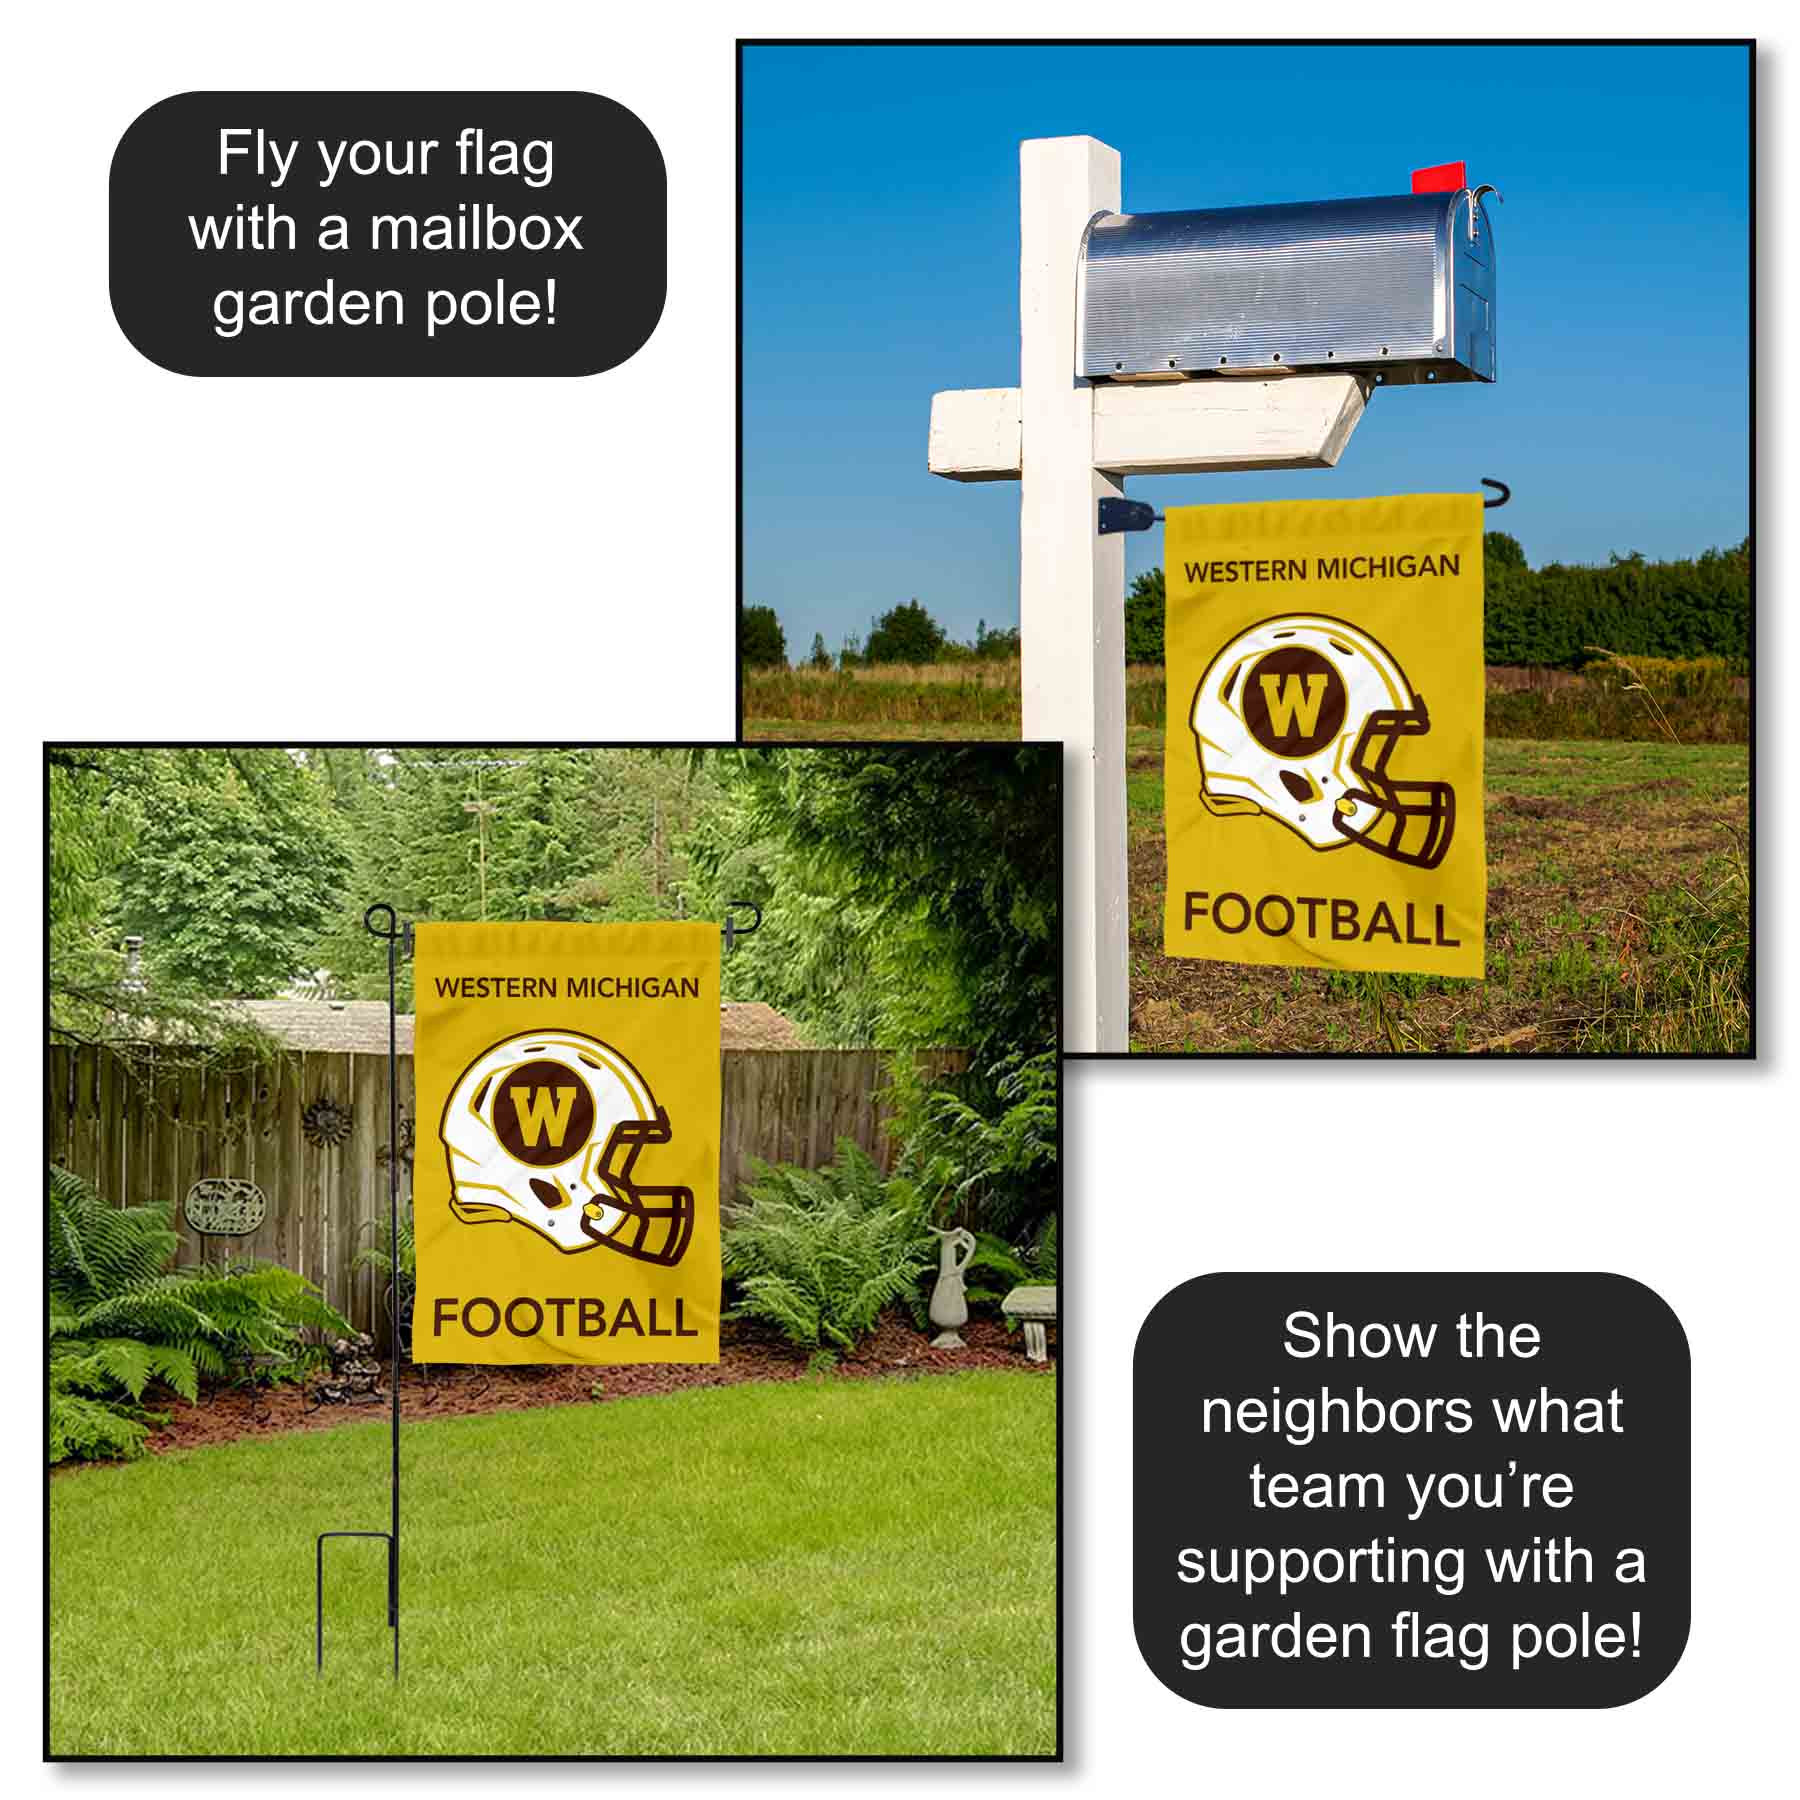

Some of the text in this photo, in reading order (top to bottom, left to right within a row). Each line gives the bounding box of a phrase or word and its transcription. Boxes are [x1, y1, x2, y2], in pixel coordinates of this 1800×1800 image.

[1183, 552, 1461, 585] WESTERN MICHIGAN
[1258, 672, 1328, 739] W
[1183, 890, 1462, 949] FOOTBALL
[434, 976, 700, 1000] WESTERN MICHIGAN
[508, 1086, 578, 1149] W
[432, 1296, 699, 1339] FOOTBALL
